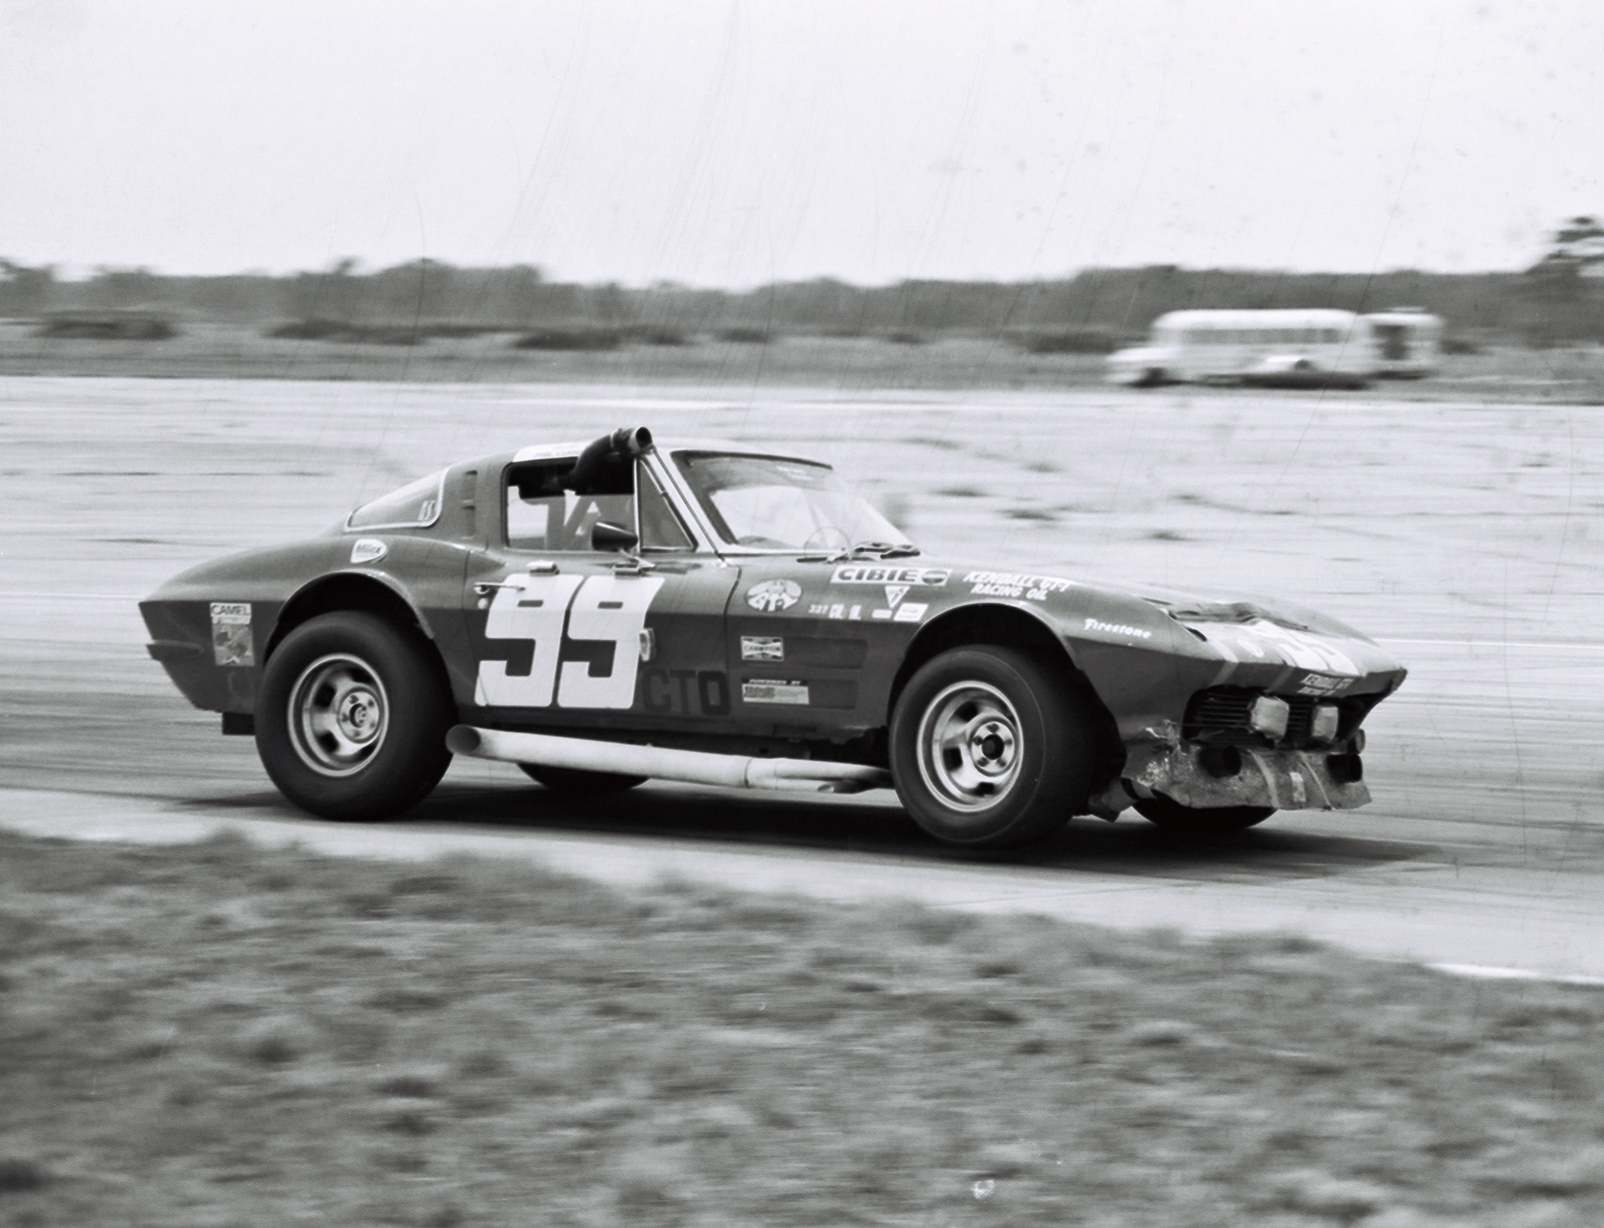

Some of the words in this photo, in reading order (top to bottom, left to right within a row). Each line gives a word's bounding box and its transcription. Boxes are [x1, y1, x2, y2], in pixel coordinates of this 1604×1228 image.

[962, 571, 1037, 588] KENDALL
[970, 583, 1023, 597] RACING
[1025, 588, 1048, 601] OIL
[1084, 618, 1151, 639] Firestone
[474, 573, 665, 709] 99
